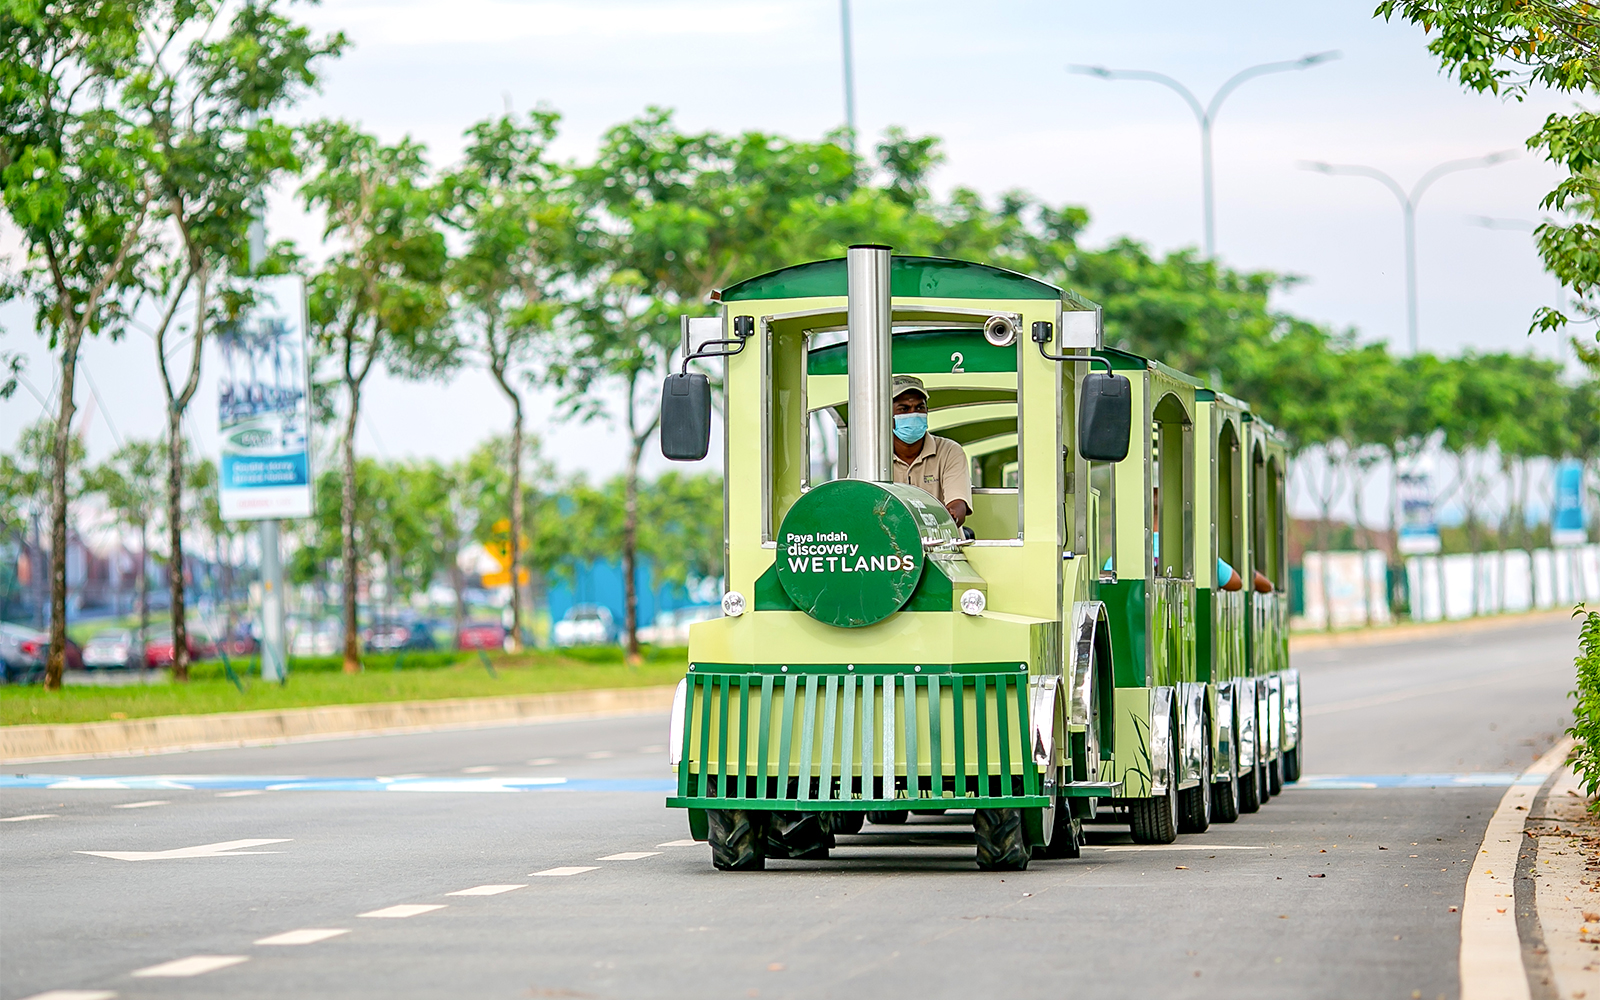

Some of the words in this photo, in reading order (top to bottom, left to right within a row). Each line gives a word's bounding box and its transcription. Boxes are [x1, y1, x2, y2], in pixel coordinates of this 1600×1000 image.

[951, 351, 965, 374] 2
[786, 533, 814, 543] Paya
[816, 531, 848, 542] Indah
[787, 543, 859, 556] discovery
[787, 555, 915, 573] WETLANDS
